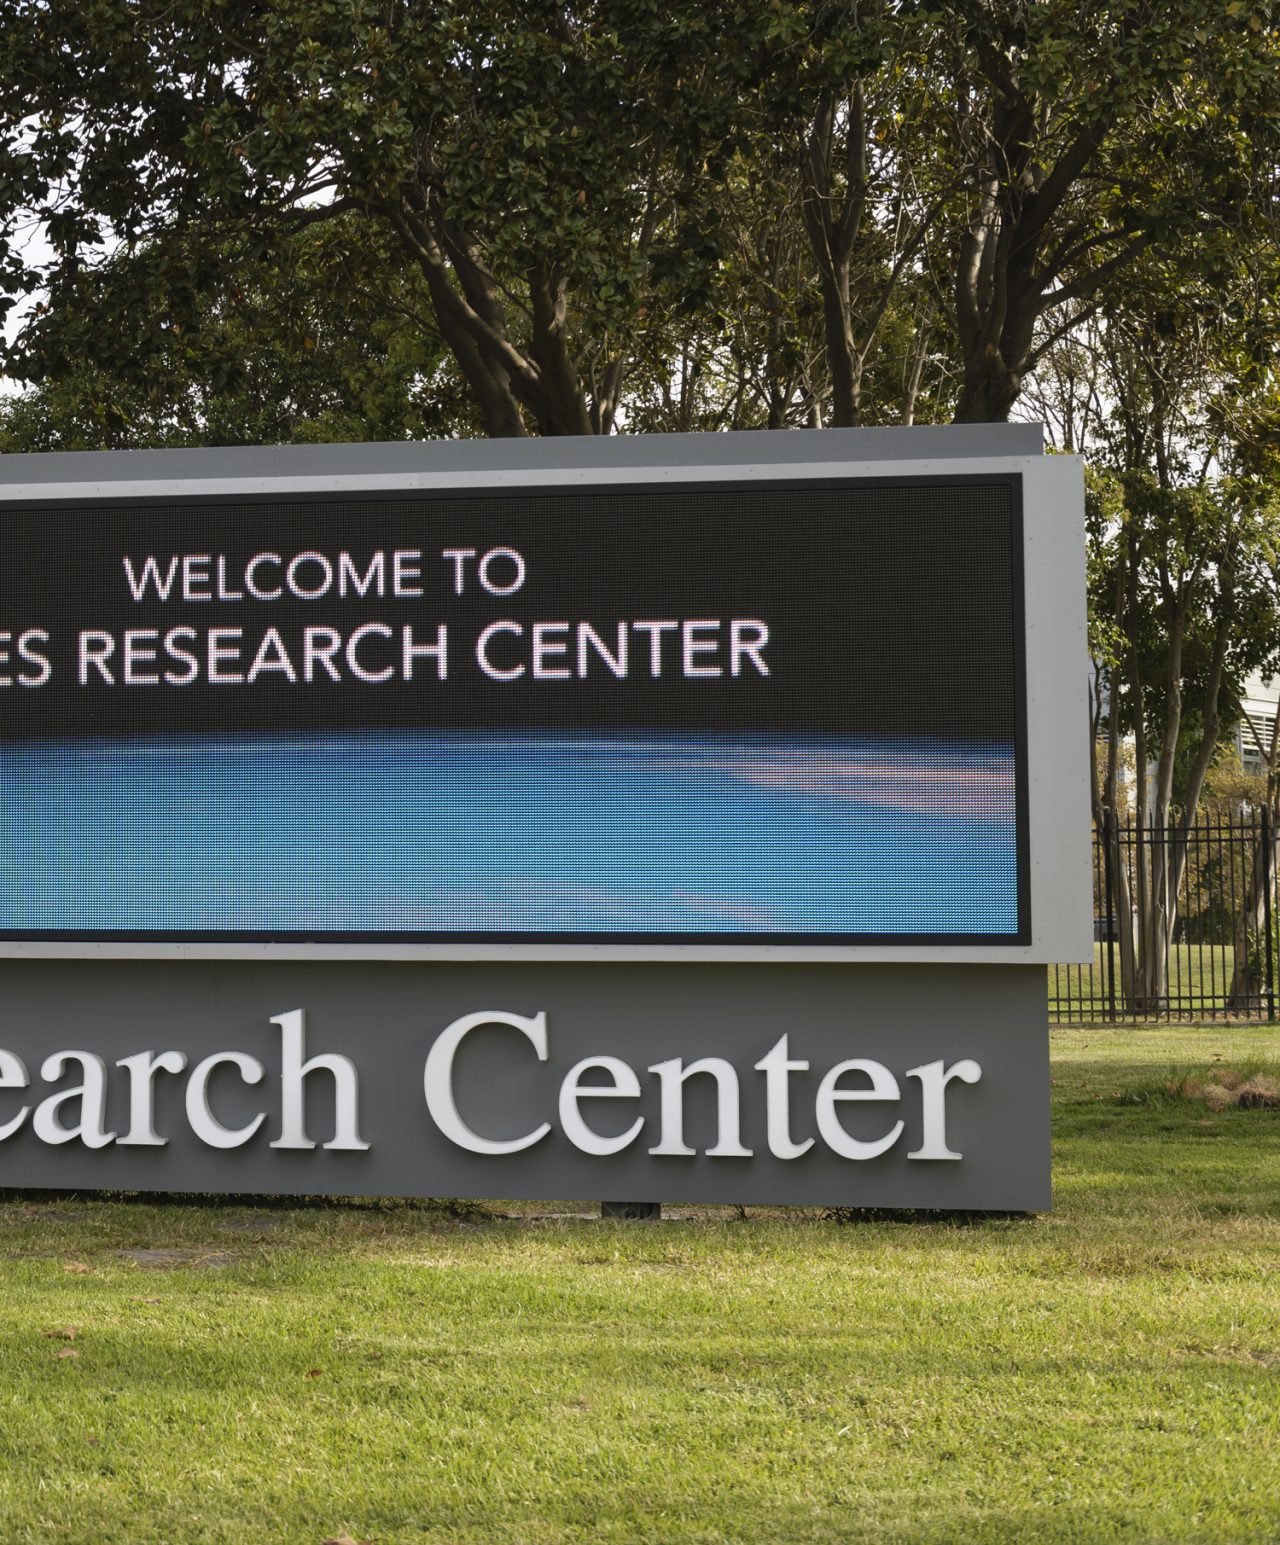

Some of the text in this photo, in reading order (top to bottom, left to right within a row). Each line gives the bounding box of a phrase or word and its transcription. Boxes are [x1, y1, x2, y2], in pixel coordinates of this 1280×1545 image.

[122, 546, 527, 603] WELCOME TO
[78, 620, 448, 687] RESEARCH
[475, 619, 771, 683] CENTER
[423, 1010, 983, 1162] Center
